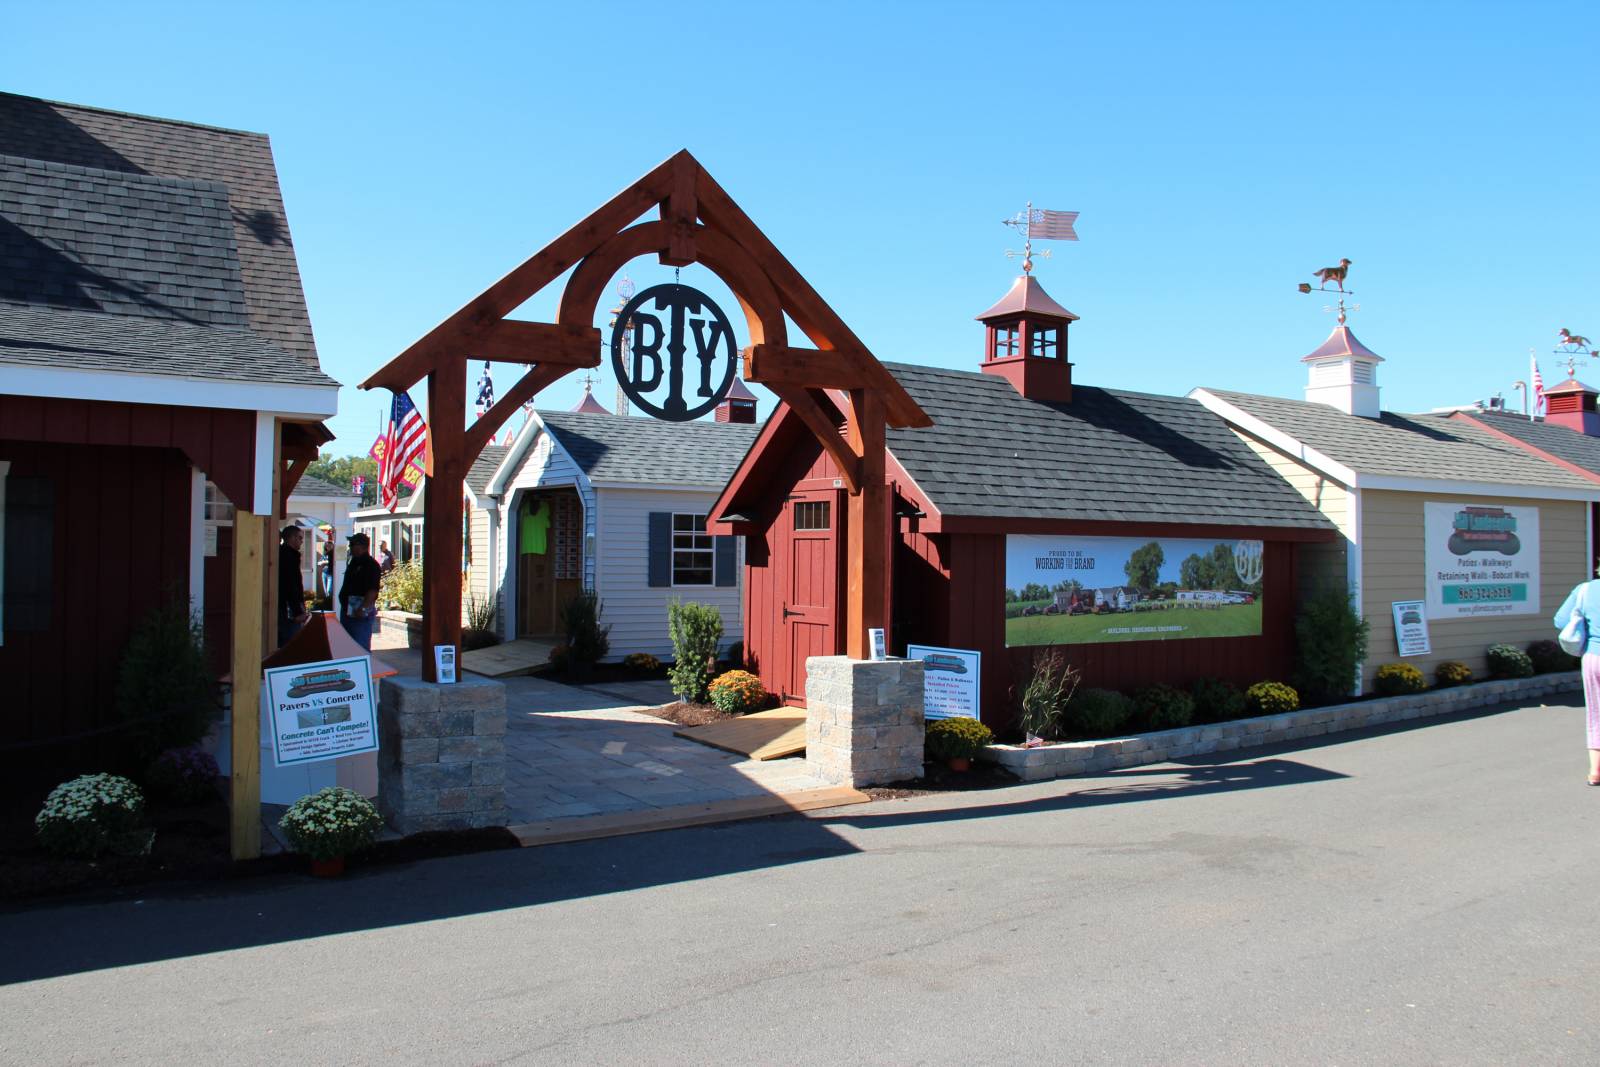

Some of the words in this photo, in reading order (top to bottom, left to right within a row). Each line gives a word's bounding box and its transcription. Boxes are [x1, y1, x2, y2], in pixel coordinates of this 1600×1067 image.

[631, 285, 722, 411] BTY
[1035, 558, 1064, 570] WORKING
[1074, 558, 1095, 570] BRAND
[1458, 558, 1477, 567] Patios
[1482, 559, 1512, 568] Walkways
[1438, 572, 1469, 582] Retaining
[1514, 571, 1530, 579] Work
[280, 700, 310, 711] Pavers
[312, 698, 324, 707] VS
[326, 693, 364, 705] Concrete
[281, 731, 314, 740] Concrete
[316, 727, 334, 736] Can't
[336, 722, 369, 732] Compete!
